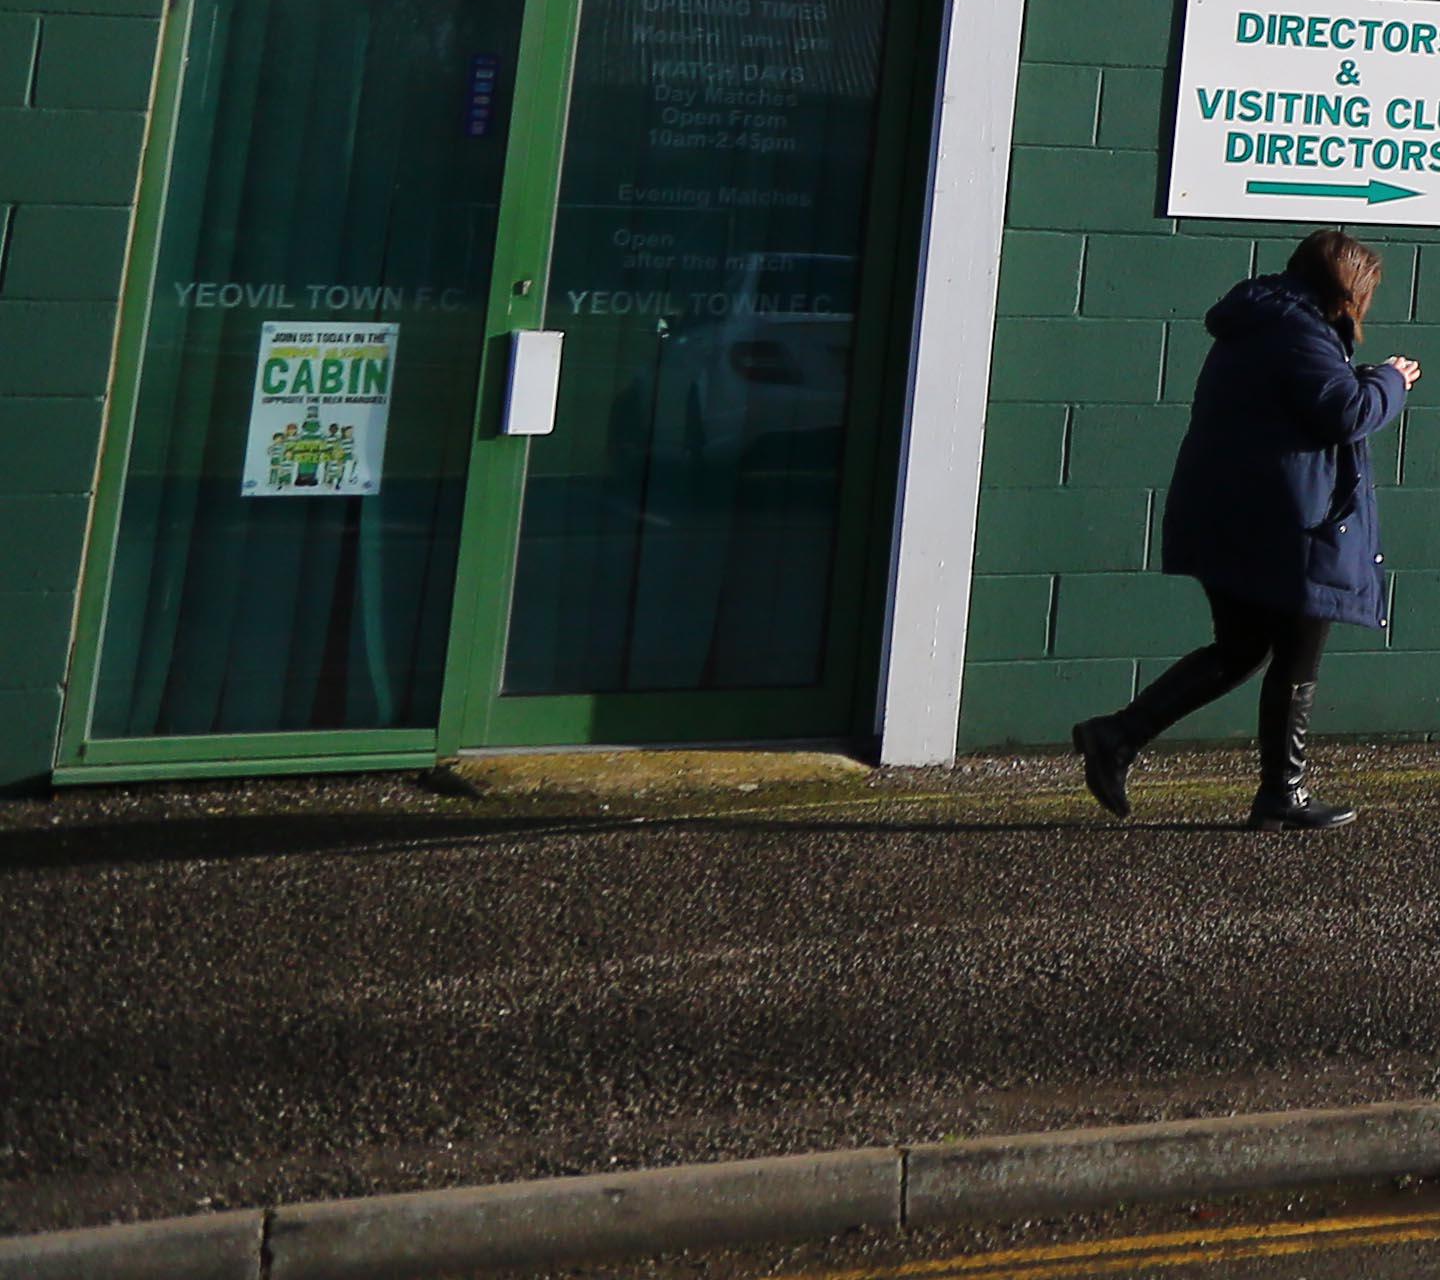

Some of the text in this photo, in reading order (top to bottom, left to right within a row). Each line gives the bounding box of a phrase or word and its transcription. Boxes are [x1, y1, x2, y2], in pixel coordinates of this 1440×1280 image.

[760, 0, 827, 21] TIMES
[652, 61, 805, 84] MATCH DAYS
[1335, 59, 1361, 86] &
[655, 84, 798, 107] Day Matches
[662, 106, 787, 129] Open From
[1196, 87, 1371, 128] VISITING
[618, 184, 812, 208] Evening Matches
[613, 228, 675, 251] Open
[174, 282, 469, 312] YEOVIL TOWN F.C.
[567, 290, 681, 316] YEOVIL
[689, 292, 778, 317] TOWN
[317, 332, 351, 343] TODAY
[262, 357, 388, 395] CABIN
